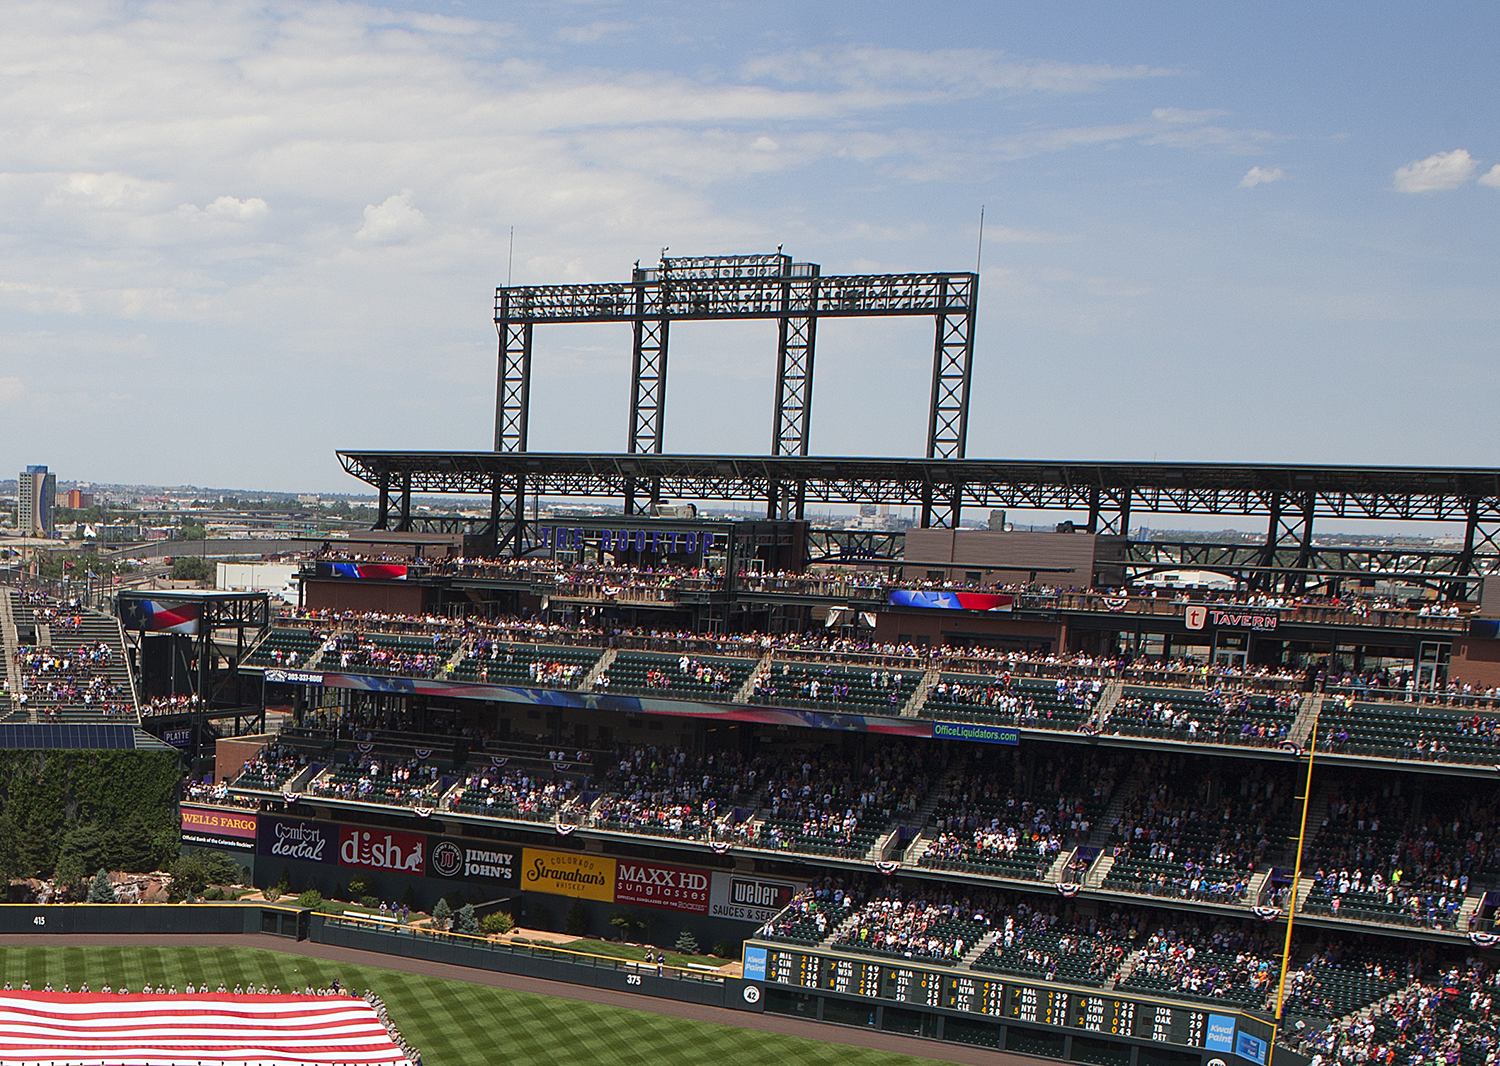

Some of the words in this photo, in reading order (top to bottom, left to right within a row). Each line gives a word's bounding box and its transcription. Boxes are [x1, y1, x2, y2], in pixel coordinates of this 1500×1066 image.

[541, 528, 584, 549] THE
[601, 529, 714, 554] ROOFTOP
[1210, 611, 1277, 628] TAVERN
[934, 725, 1017, 741] OfficeLiquidators.com
[182, 813, 219, 826] WELLS
[220, 818, 257, 831] FARGO
[272, 838, 326, 861] dental
[341, 830, 405, 869] dish
[465, 849, 513, 865] JIMMY
[551, 857, 594, 871] COLORADO
[464, 863, 512, 880] JOHN'S
[526, 858, 605, 886] Stranahan's
[618, 865, 676, 887] MAXX
[679, 872, 708, 891] HD
[556, 882, 585, 891] WHISKEY
[617, 882, 706, 901] sunglasses
[734, 877, 779, 906] weber
[712, 904, 745, 918] SAUCES
[747, 909, 753, 919] &
[33, 916, 46, 926] 415
[747, 955, 765, 964] Kwal
[779, 952, 792, 960] MIL
[746, 963, 765, 973] Paint
[778, 960, 792, 968] CIN
[778, 968, 790, 976] ARI
[898, 970, 913, 978] MIA
[626, 974, 641, 985] 375
[777, 976, 789, 984] ATL
[836, 977, 849, 985] PHI
[897, 977, 909, 985] STL
[896, 985, 906, 993] SF
[958, 986, 975, 995] NYM
[1022, 987, 1036, 996] BAL
[746, 992, 756, 1001] 42
[896, 994, 906, 1002] SD
[957, 995, 968, 1003] KC
[1021, 996, 1037, 1004] BOS
[1088, 997, 1103, 1006] SEA
[957, 1003, 970, 1011] CLE
[1020, 1005, 1037, 1013] NYY
[1087, 1005, 1104, 1014] CHW
[1156, 1007, 1171, 1016] TOR
[1020, 1013, 1037, 1022] MIN
[1086, 1014, 1104, 1023] HOU
[1155, 1016, 1171, 1025] OAK
[1085, 1023, 1100, 1031] LAA
[1153, 1024, 1163, 1033] TB
[1210, 1024, 1233, 1034] Kwal
[1152, 1033, 1167, 1042] DET
[1208, 1032, 1232, 1044] Paint
